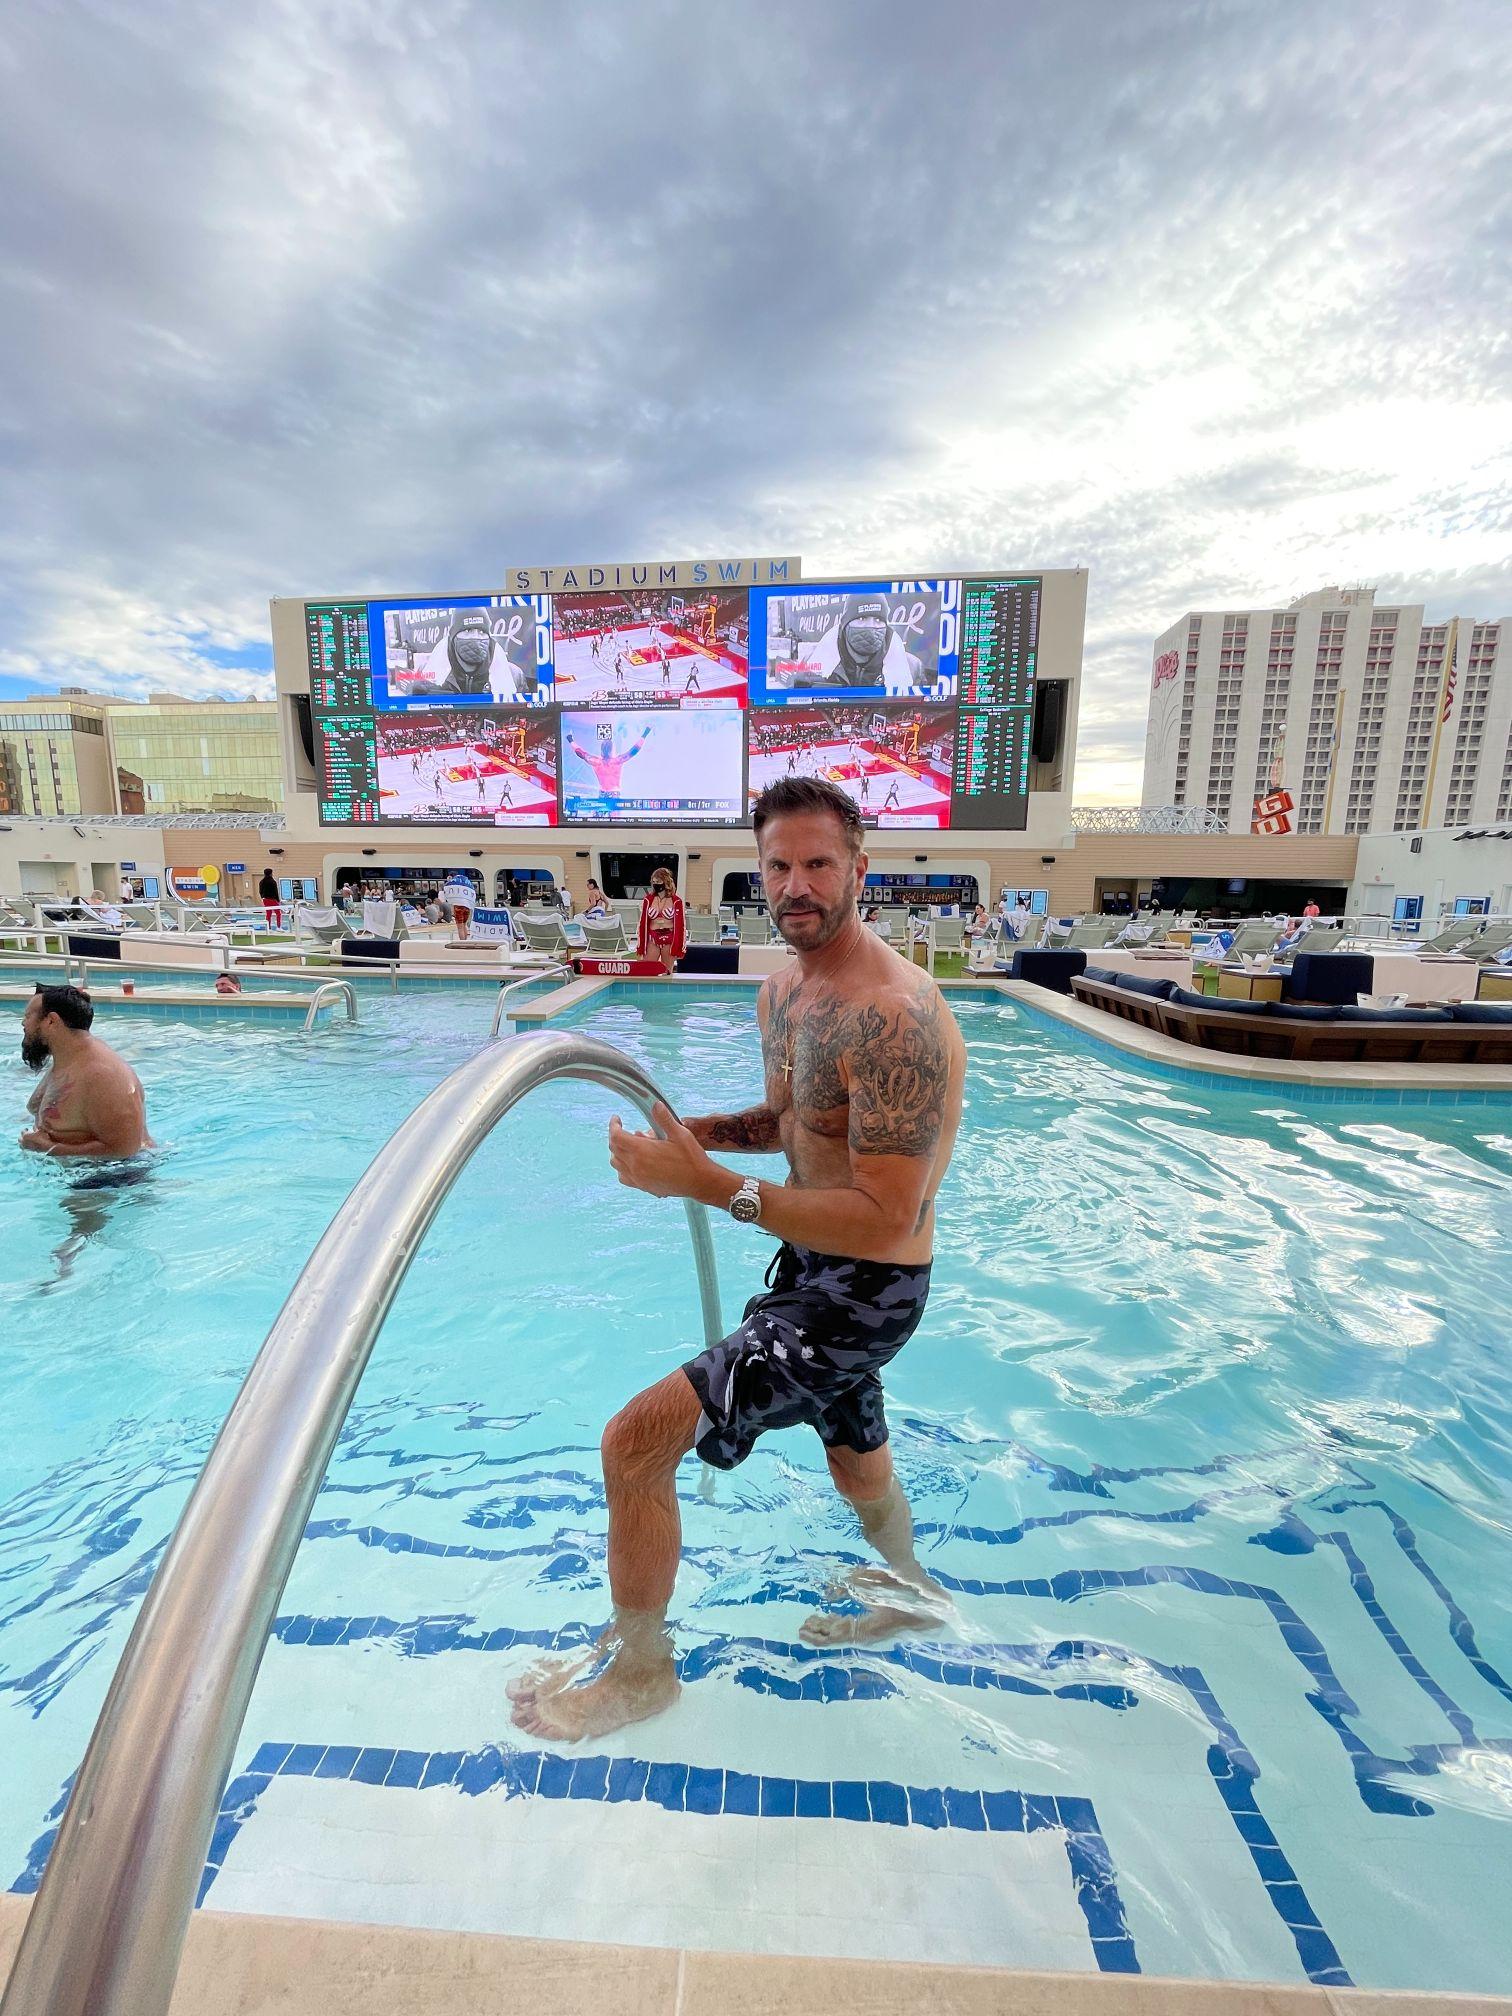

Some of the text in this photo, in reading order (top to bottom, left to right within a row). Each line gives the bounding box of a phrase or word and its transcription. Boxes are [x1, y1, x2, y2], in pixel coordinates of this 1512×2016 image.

[516, 560, 789, 589] STADIUM SWIM
[597, 727, 612, 736] PG
[715, 801, 730, 809] FOX
[598, 962, 631, 974] GUARD
